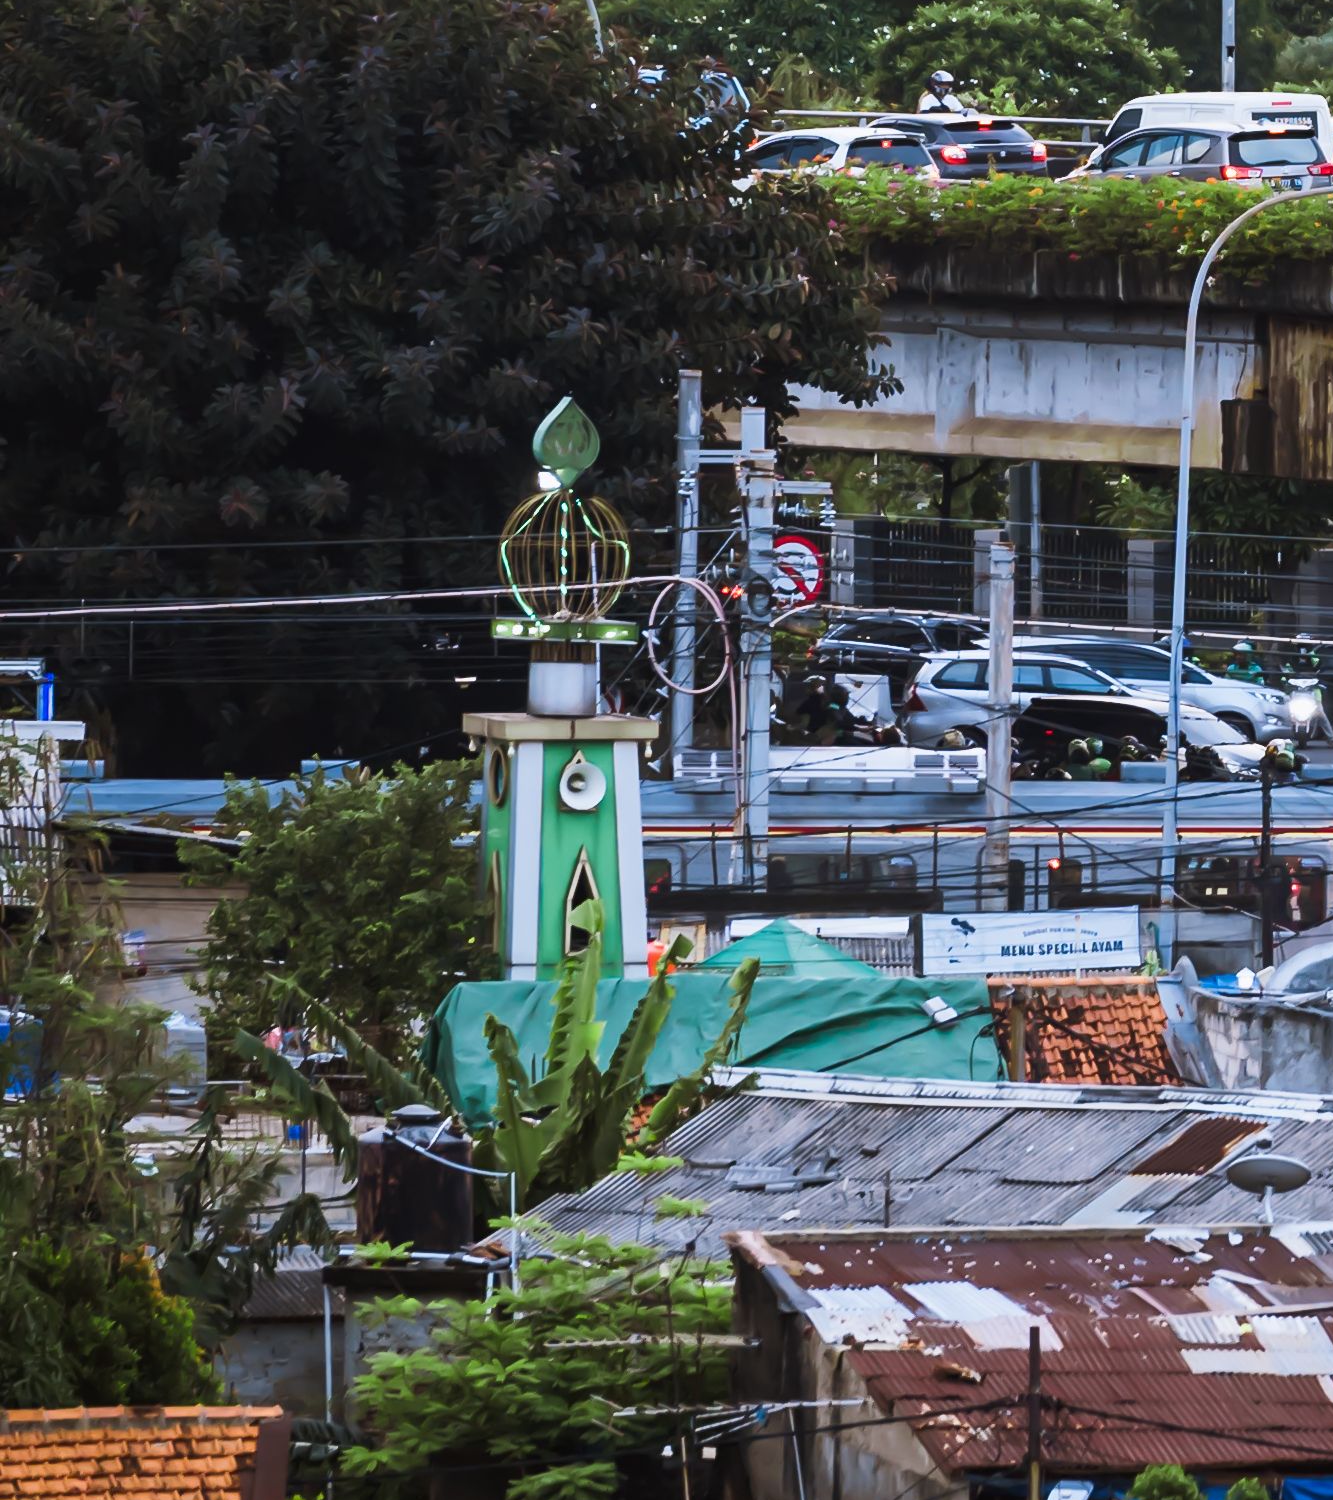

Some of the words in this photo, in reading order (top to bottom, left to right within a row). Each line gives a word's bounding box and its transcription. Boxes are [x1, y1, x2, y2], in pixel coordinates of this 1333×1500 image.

[1000, 944, 1035, 957] MENU
[1039, 942, 1088, 956] SPECIL
[1091, 940, 1124, 953] AYAM
